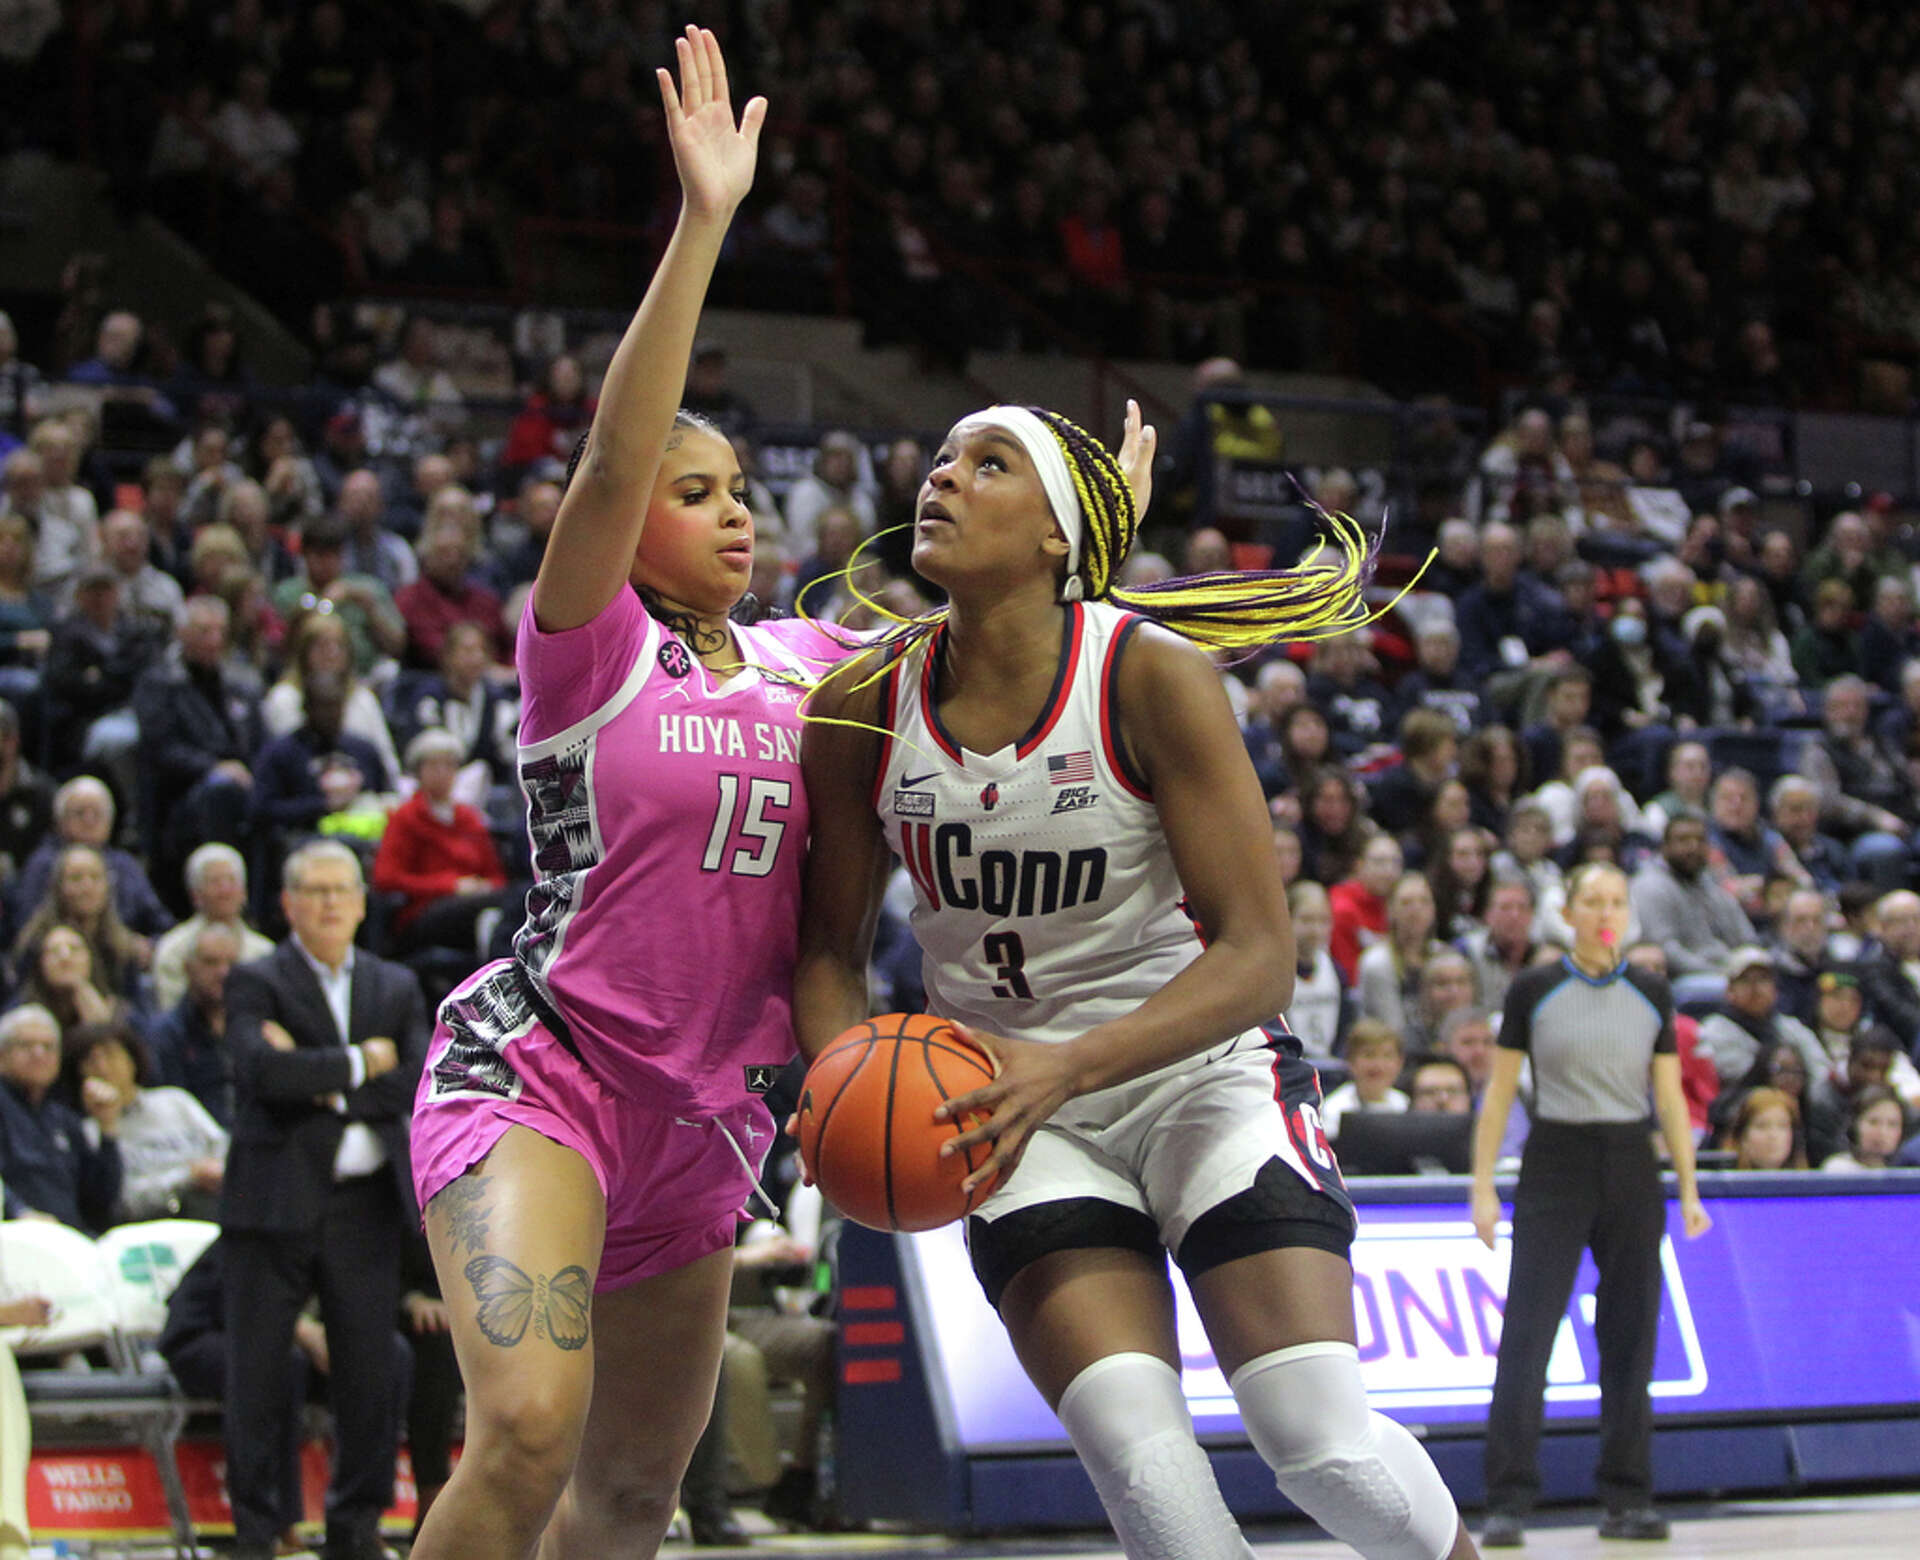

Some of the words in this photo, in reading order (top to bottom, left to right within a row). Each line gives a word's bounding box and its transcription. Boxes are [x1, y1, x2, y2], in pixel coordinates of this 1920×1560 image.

[659, 714, 747, 758] HOYA
[1054, 794, 1100, 809] EAST
[1057, 786, 1090, 799] BIG
[700, 773, 791, 878] 15
[983, 931, 1034, 999] 3
[41, 1464, 126, 1488] WELLS
[50, 1489, 133, 1513] FARGO
